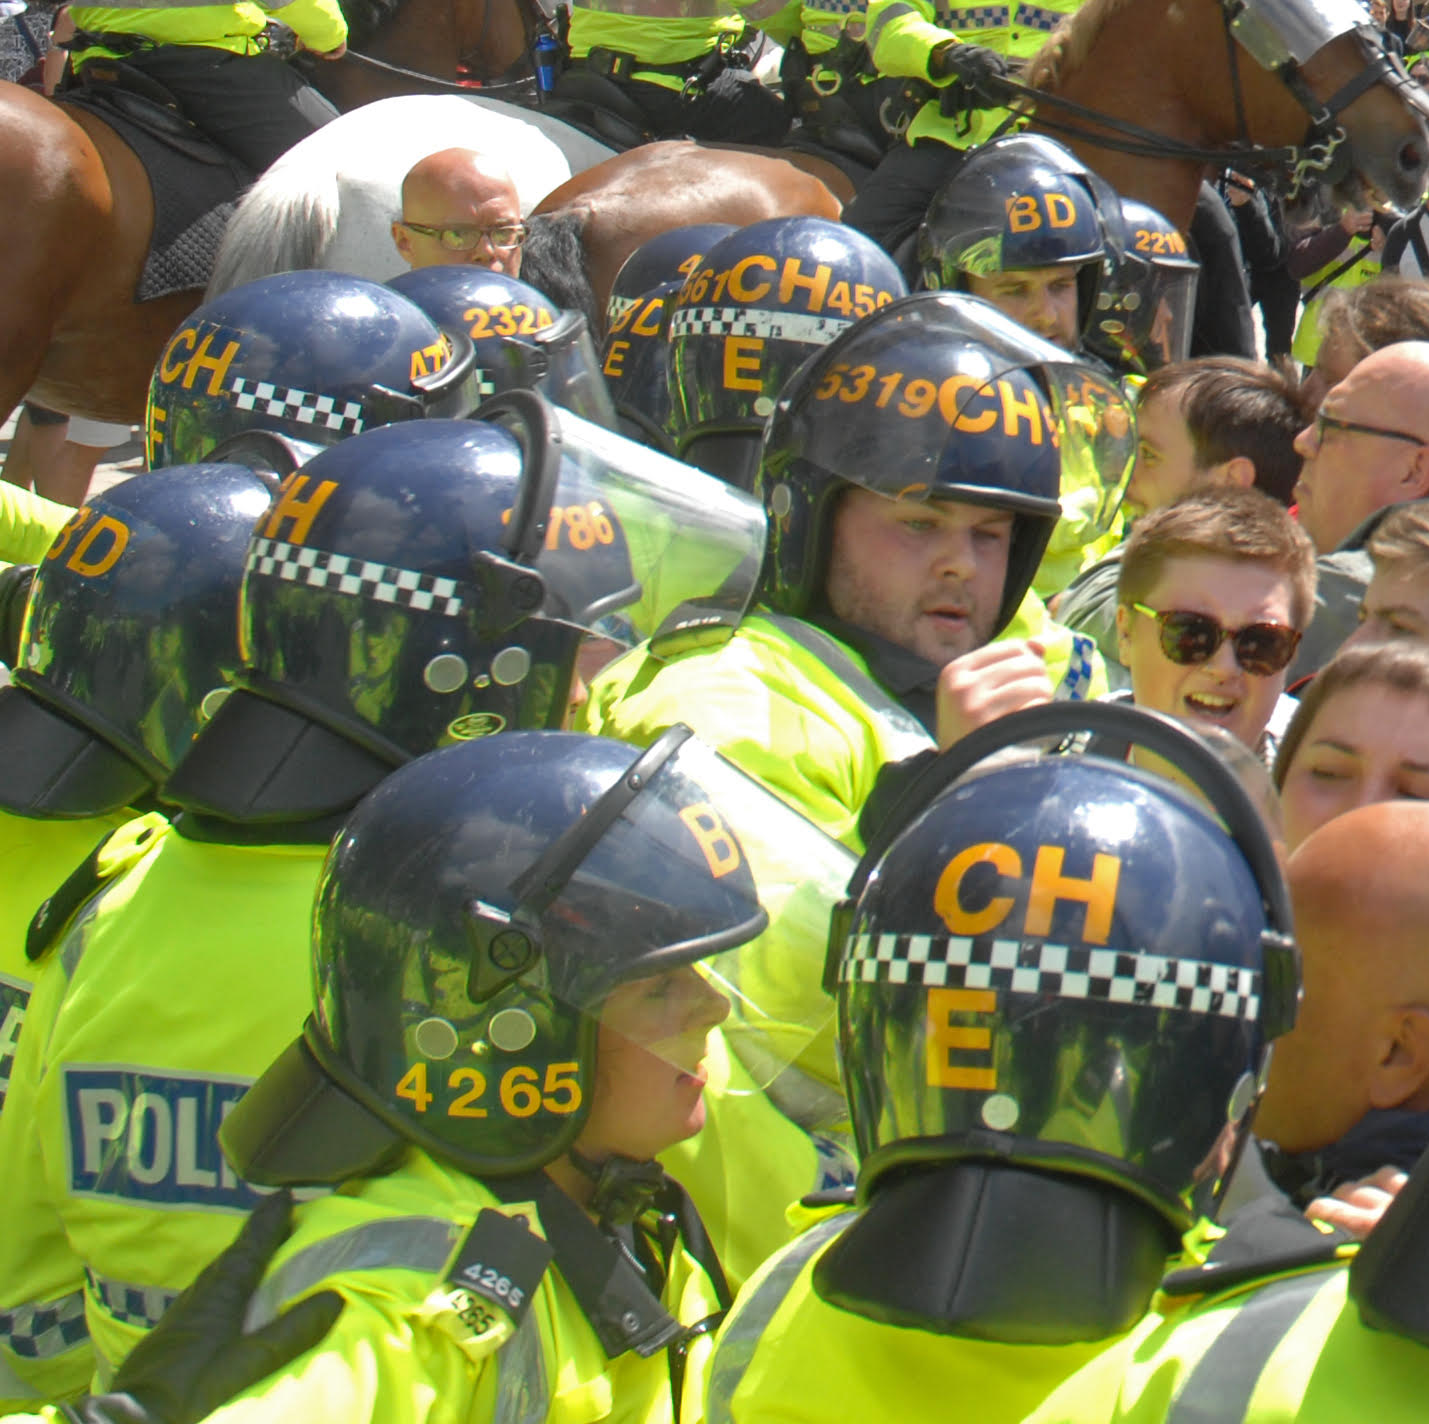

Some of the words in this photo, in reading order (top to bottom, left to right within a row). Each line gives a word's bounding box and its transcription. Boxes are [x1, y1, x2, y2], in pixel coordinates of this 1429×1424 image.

[1006, 193, 1076, 234] BD
[726, 254, 833, 313] CH
[159, 326, 241, 396] CH
[723, 336, 764, 391] E
[814, 364, 936, 419] 5319
[937, 372, 1043, 446] CH
[257, 475, 338, 545] H
[933, 842, 1122, 946] CH
[926, 987, 997, 1090] E
[395, 1062, 583, 1118] 4265
[77, 1087, 246, 1188] POLI
[449, 1289, 492, 1338] 4265
[464, 1261, 525, 1307] 4265
